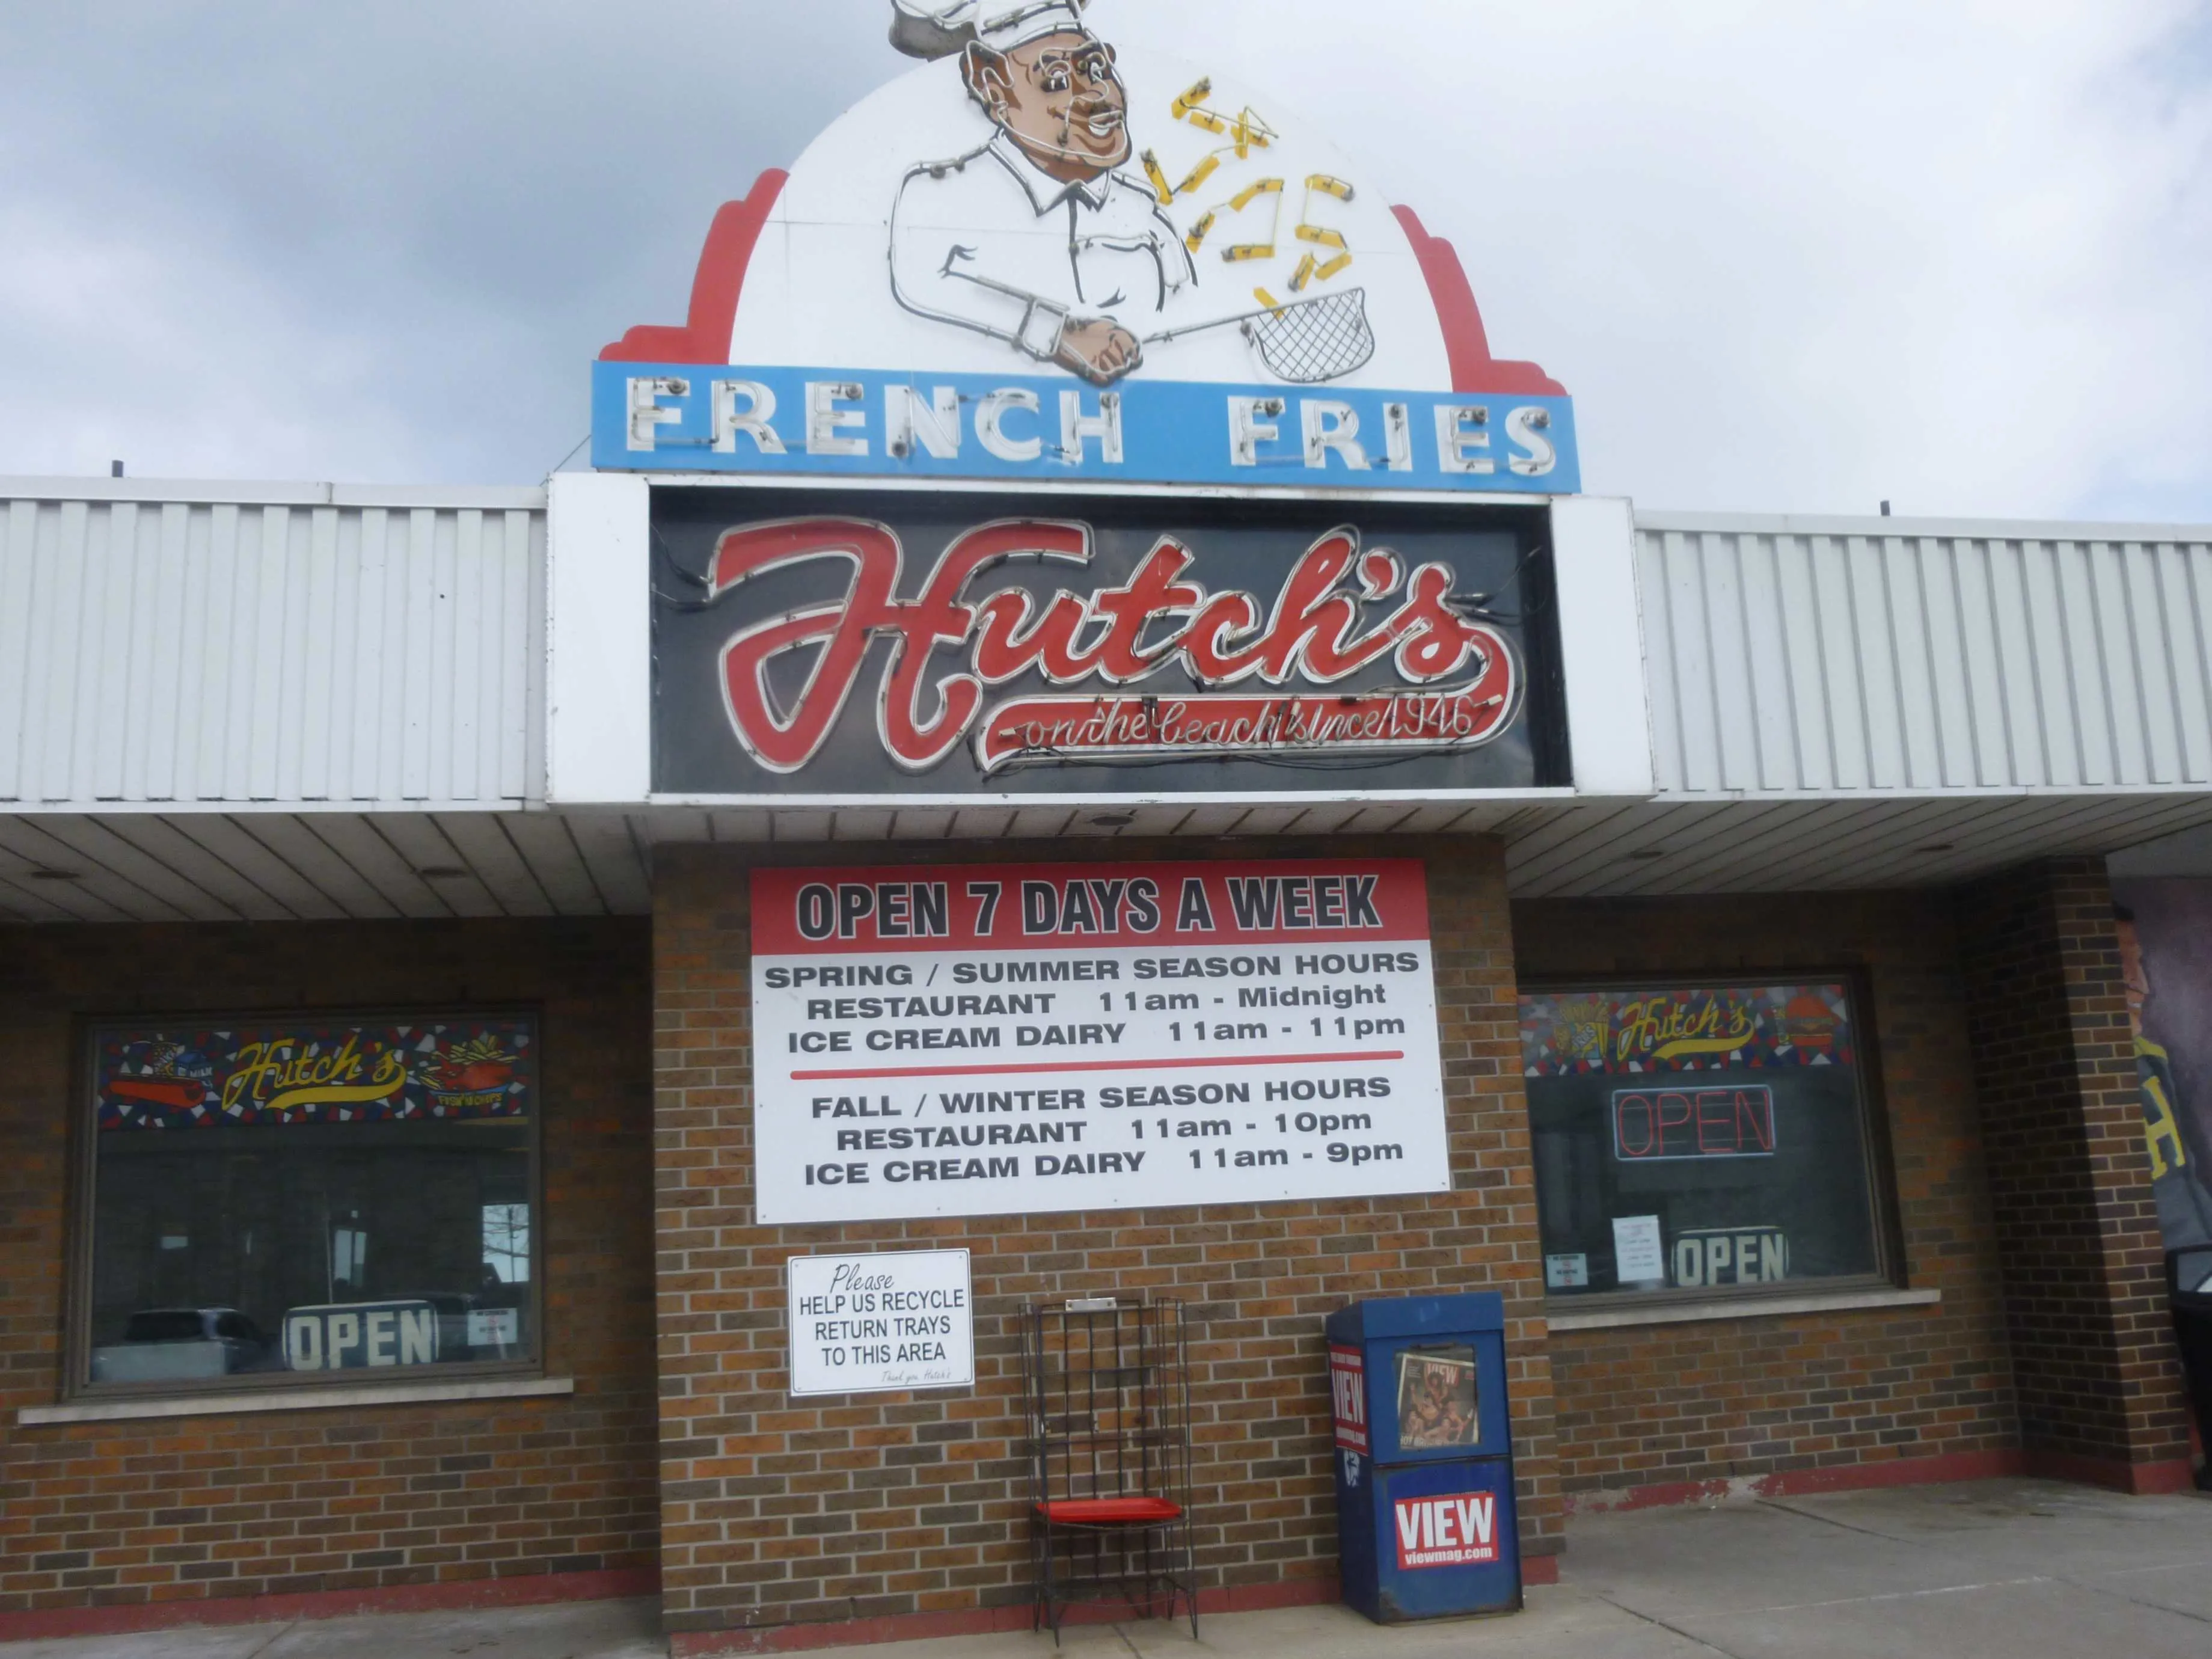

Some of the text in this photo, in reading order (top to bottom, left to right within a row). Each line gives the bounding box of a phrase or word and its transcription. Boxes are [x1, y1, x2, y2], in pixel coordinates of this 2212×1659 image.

[626, 377, 1557, 476] FRENCH FRIES
[708, 515, 1524, 774] Hutch's
[1025, 720, 1081, 746] on
[1081, 698, 1148, 744] the
[1153, 701, 1282, 744] beach
[1379, 693, 1472, 738] 1946
[795, 874, 1383, 940] OPEN 7 DAYS A WEEK
[765, 964, 913, 988] SPRING
[952, 960, 1120, 985] SUMMER
[1133, 956, 1281, 980] SEASON
[1295, 952, 1420, 975] HOURS
[807, 993, 1056, 1020] RESTAURANT
[1099, 990, 1199, 1012] 11am
[1237, 983, 1386, 1010] Midnight
[789, 1031, 852, 1053] ICE
[865, 1026, 1000, 1051] CREAM
[1016, 1023, 1126, 1047] DAIRY
[1169, 1020, 1267, 1042] 11am
[1310, 1017, 1406, 1040] 11pm
[1617, 993, 1756, 1062] Hutch's
[222, 1034, 408, 1111] Hutch's
[812, 1095, 902, 1118] FALL
[939, 1089, 1086, 1114] WINTER
[1099, 1082, 1251, 1108] SEASON
[1264, 1076, 1391, 1102] HOURS
[837, 1121, 1088, 1150] RESTAURANT
[1131, 1117, 1231, 1139] 11am
[1274, 1111, 1372, 1135] 10pm
[1619, 1090, 1773, 1156] OPEN
[805, 1162, 870, 1186] ICE
[883, 1156, 1019, 1182] CREAM
[1035, 1150, 1147, 1177] DAIRY
[1189, 1147, 1288, 1169] 11am
[1326, 1142, 1404, 1166] 9pm
[830, 1263, 895, 1293] Please
[1676, 1234, 1785, 1287] OPEN
[800, 1289, 964, 1315] HELP US RECYCLE
[289, 1309, 432, 1371] OPEN
[815, 1316, 951, 1340] RETURN TRAYS
[821, 1342, 946, 1366] TO THIS AREA
[1331, 1368, 1364, 1425] VIEW
[1396, 1497, 1494, 1550] VIEW
[1405, 1547, 1493, 1566] viewmag.com
